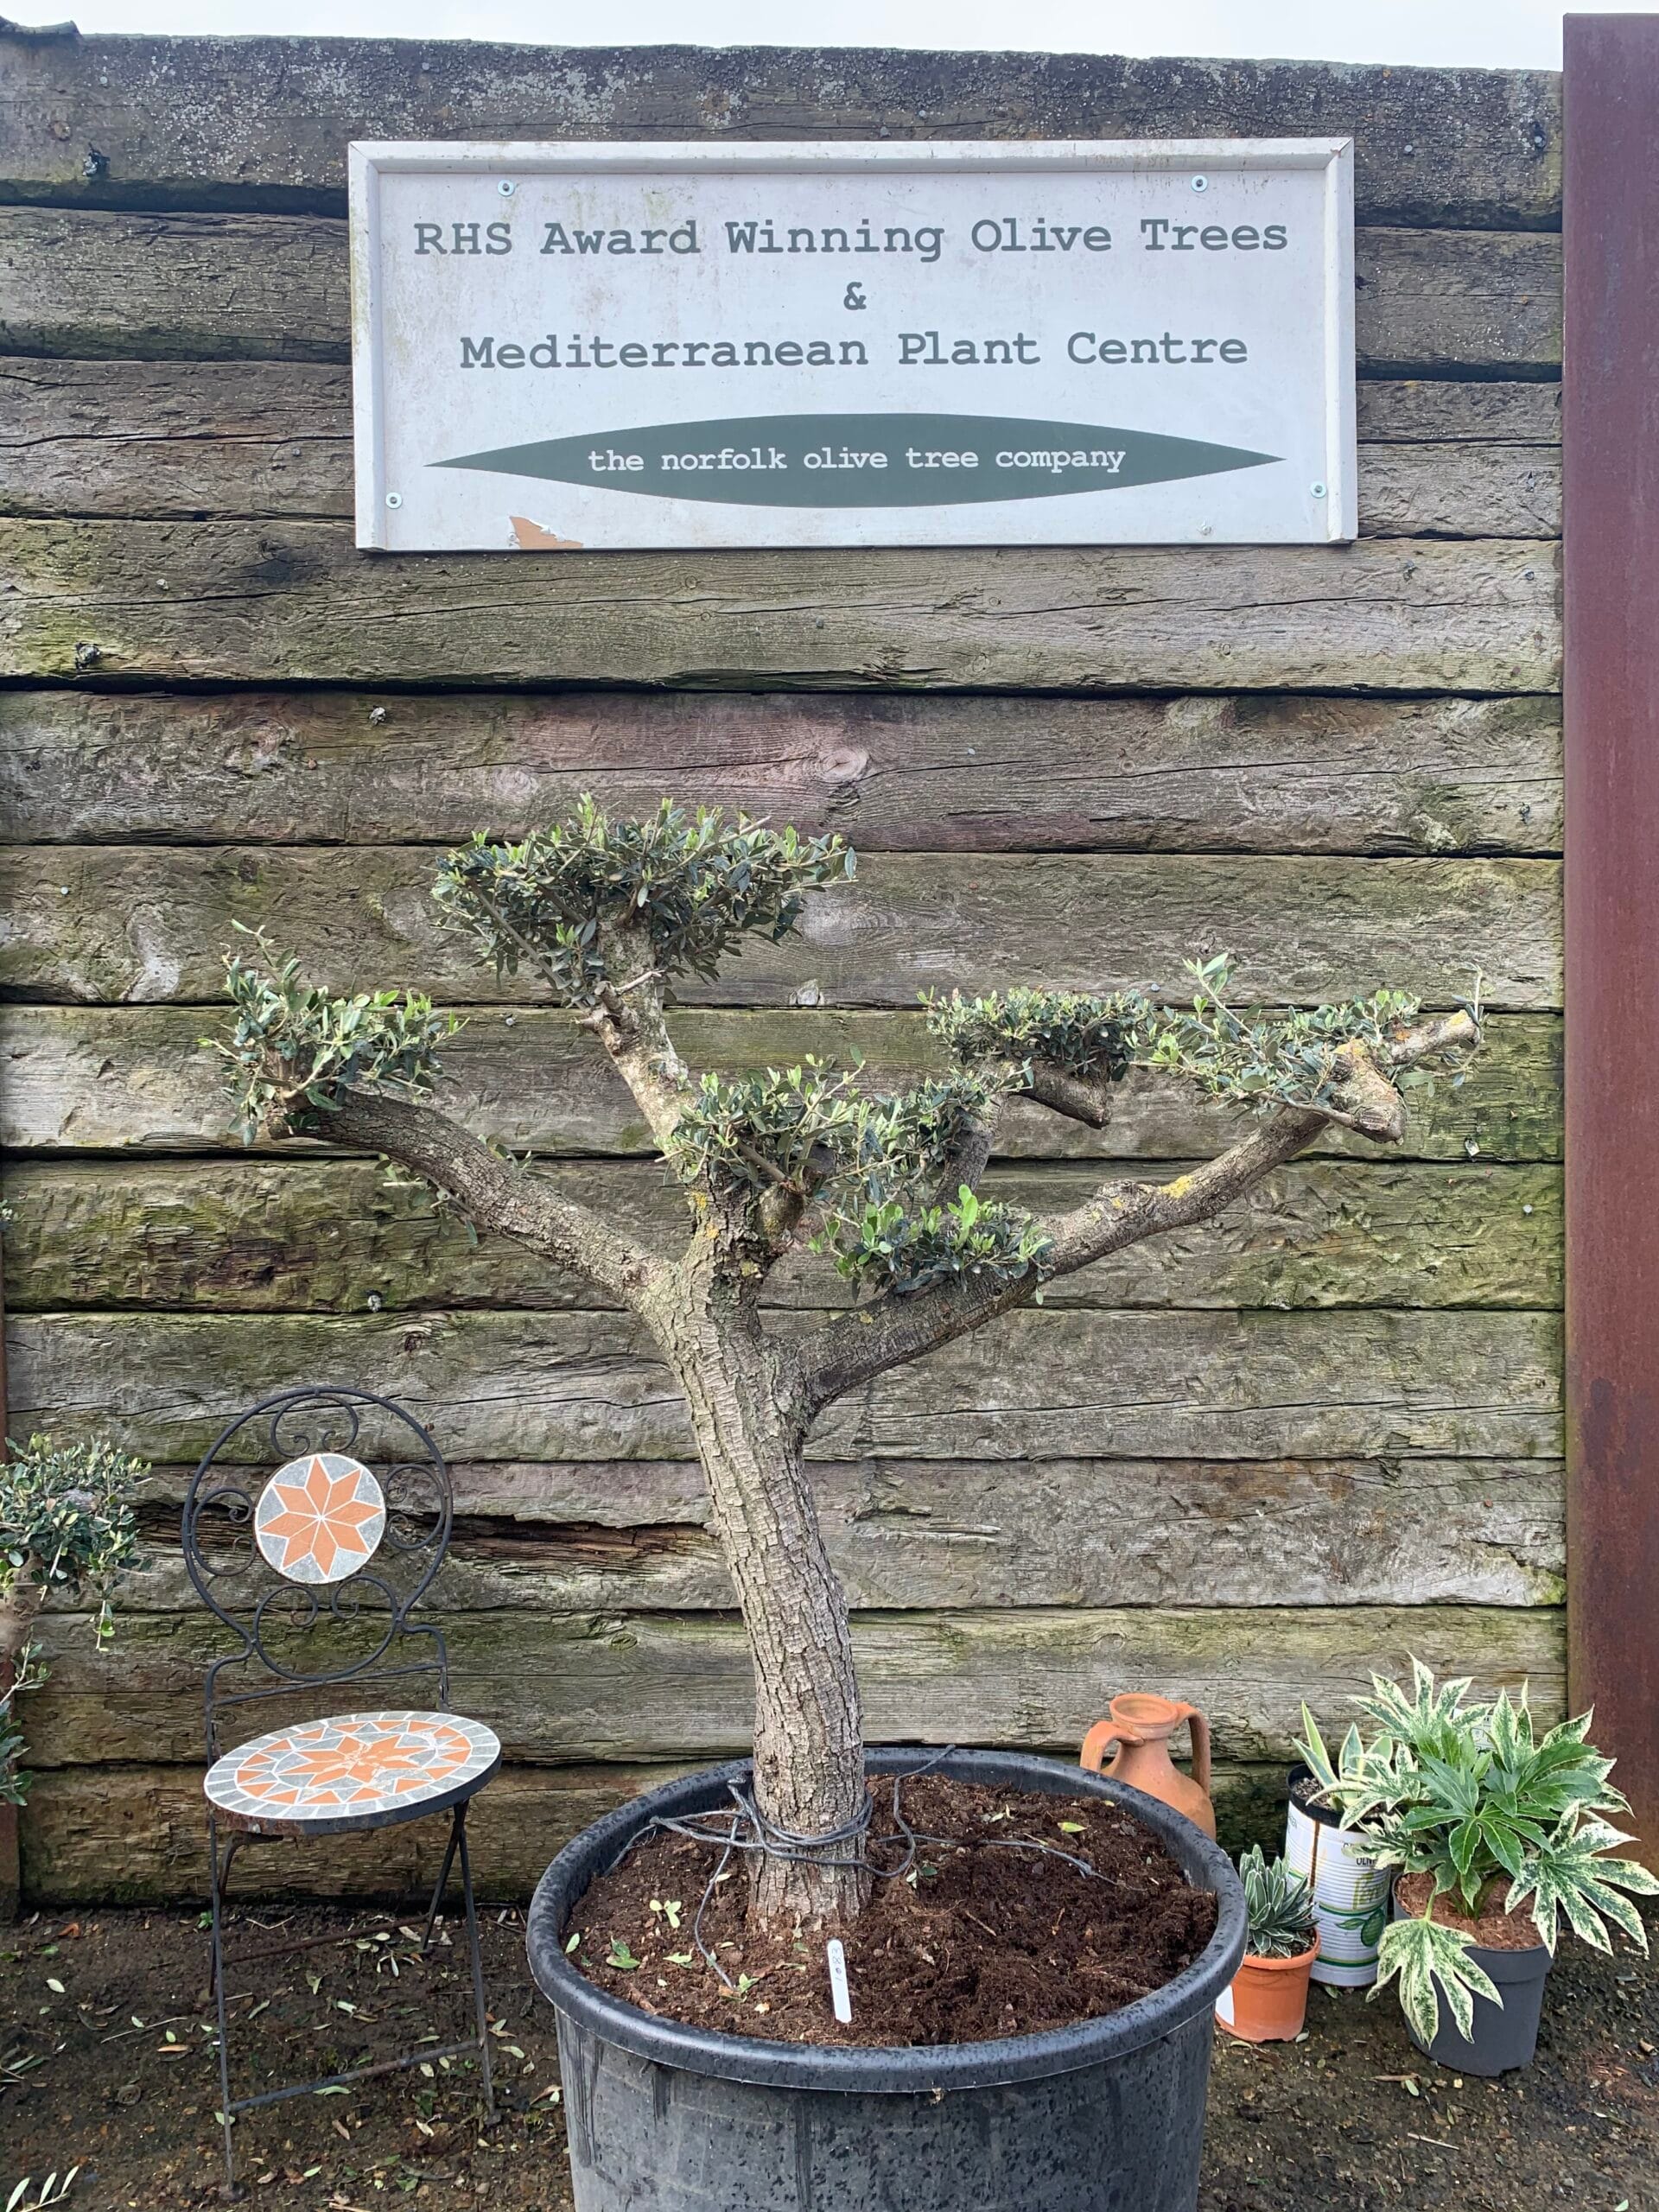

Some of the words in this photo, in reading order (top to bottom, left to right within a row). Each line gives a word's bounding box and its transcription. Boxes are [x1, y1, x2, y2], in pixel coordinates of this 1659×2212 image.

[414, 221, 512, 256] RHS
[539, 219, 702, 255] Award
[724, 218, 945, 264] Winning
[971, 217, 1112, 252] Olive
[1140, 219, 1288, 251] Trees
[843, 281, 868, 311] &
[460, 334, 869, 369] Mediterranean
[898, 331, 1041, 365] Plant
[1067, 331, 1248, 365] Centre
[588, 449, 645, 472] the
[661, 447, 788, 471] norfolk
[803, 447, 888, 469] olive
[905, 447, 979, 468] tree
[995, 450, 1127, 474] company
